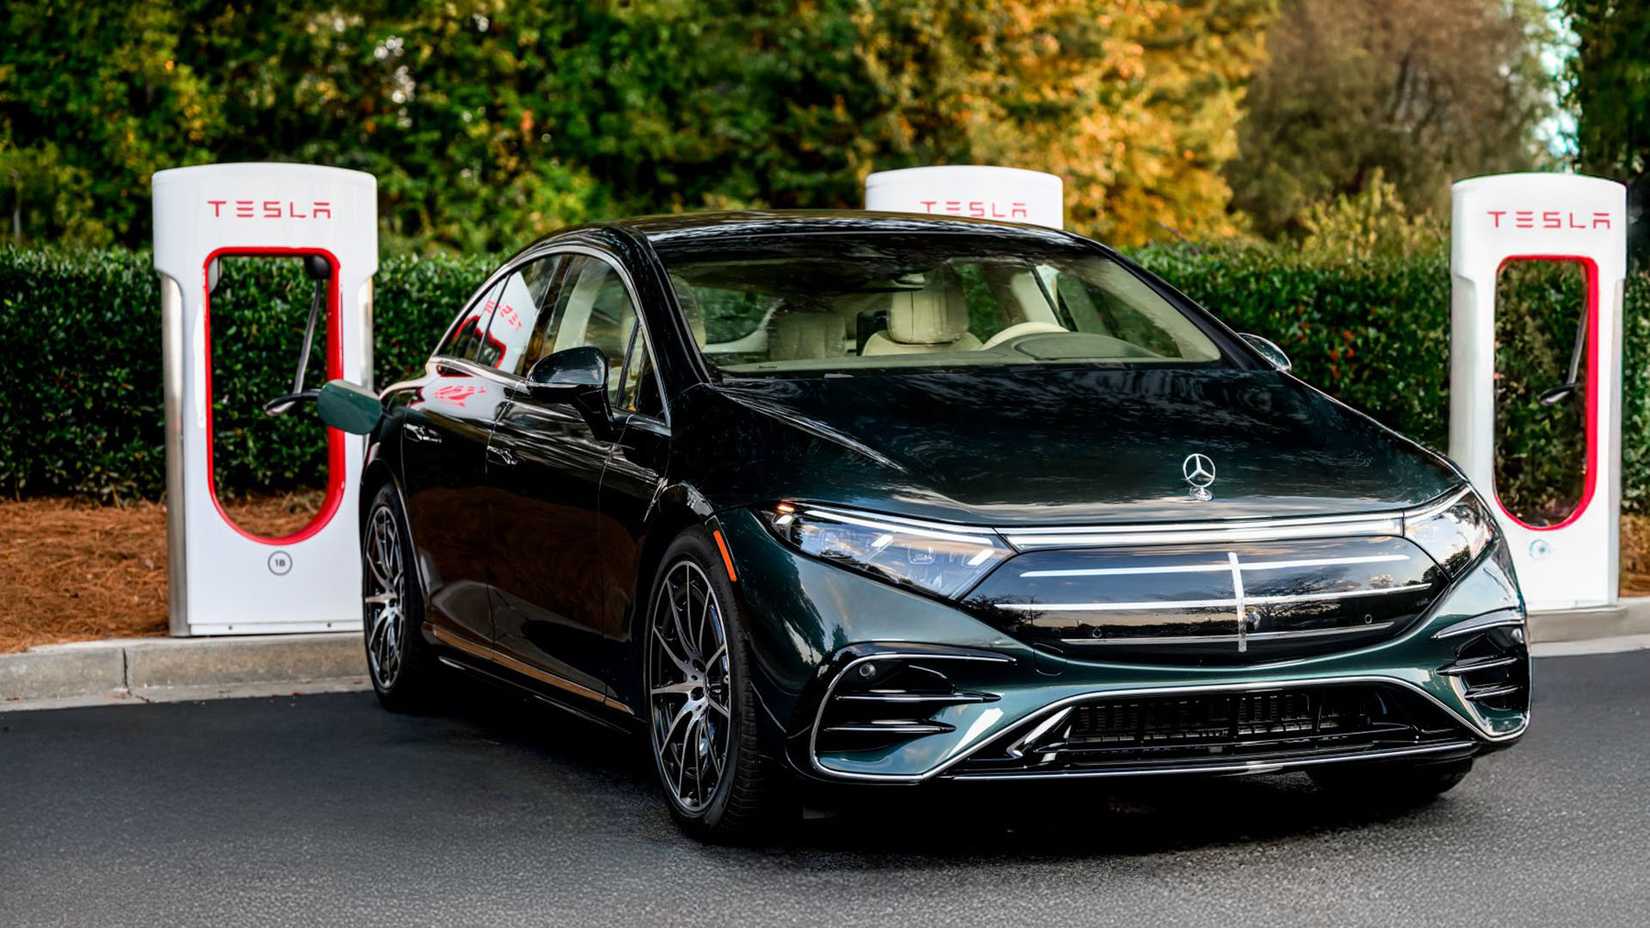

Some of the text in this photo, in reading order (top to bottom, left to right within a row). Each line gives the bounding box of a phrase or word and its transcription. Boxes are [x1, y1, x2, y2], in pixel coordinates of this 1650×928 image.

[207, 200, 332, 219] TESLA
[920, 201, 1028, 218] TESLA
[1487, 211, 1611, 229] TESLA
